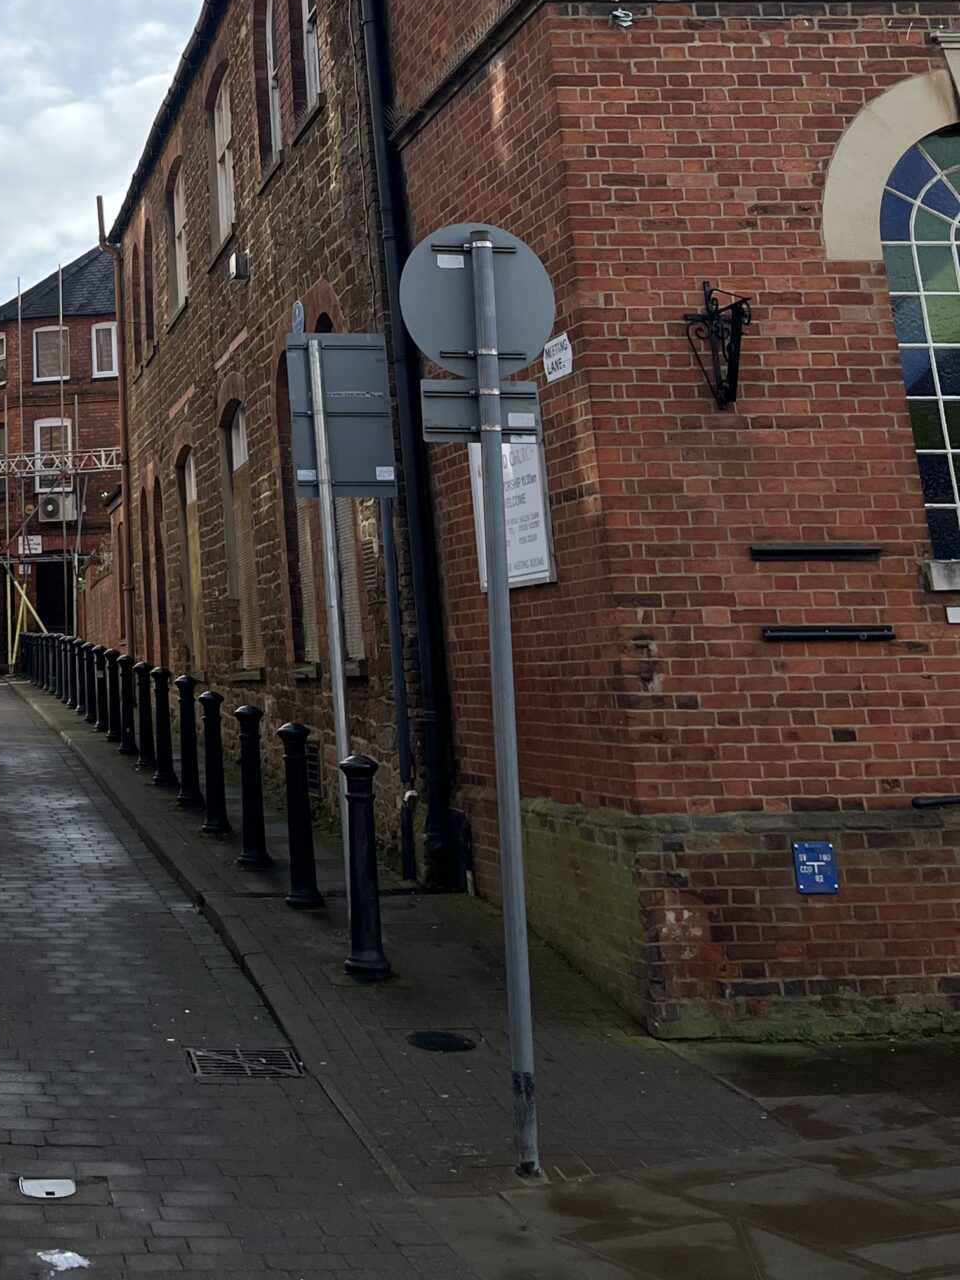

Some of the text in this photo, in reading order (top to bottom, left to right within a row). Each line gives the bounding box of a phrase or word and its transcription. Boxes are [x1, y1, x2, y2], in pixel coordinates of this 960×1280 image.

[544, 337, 569, 360] MEETING
[546, 357, 566, 376] LANE
[504, 492, 526, 509] ELCOME
